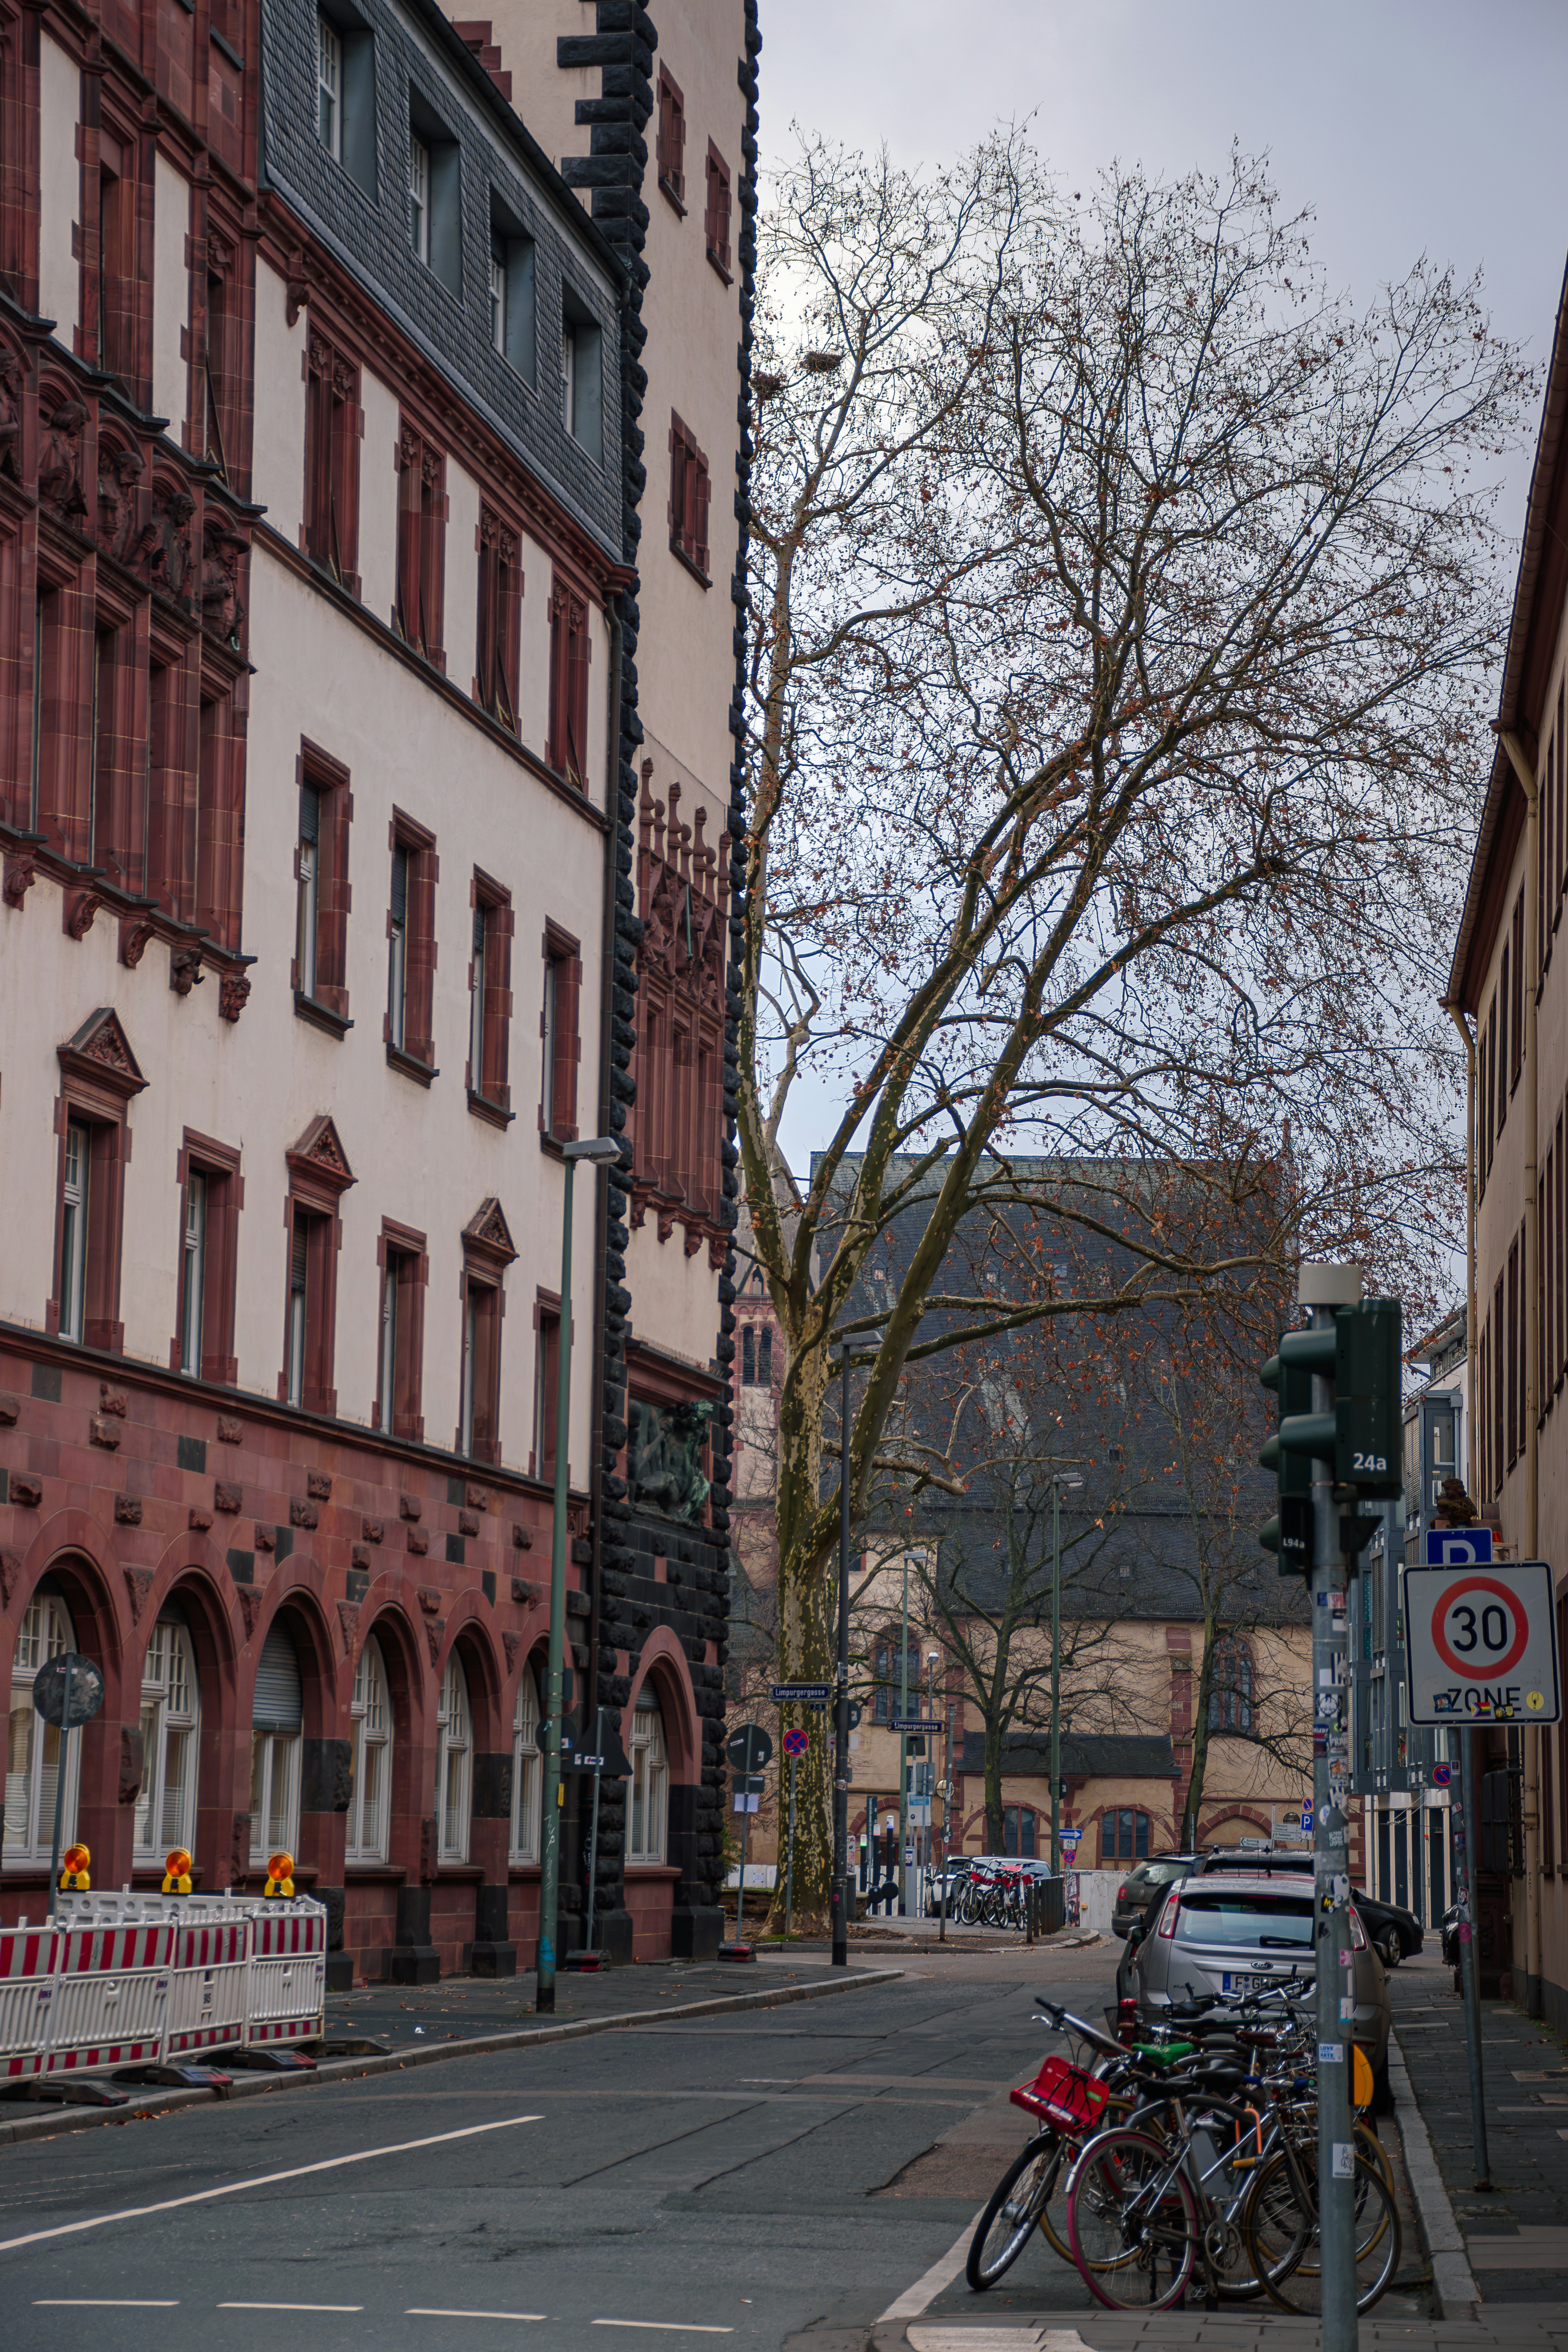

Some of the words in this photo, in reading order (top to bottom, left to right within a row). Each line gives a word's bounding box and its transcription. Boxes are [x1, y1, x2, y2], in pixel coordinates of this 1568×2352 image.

[1353, 1452, 1387, 1471] 24a
[1283, 1537, 1305, 1548] L94a
[1451, 1604, 1508, 1651] 30
[775, 1688, 825, 1697] Limpurgergasse
[1447, 1687, 1522, 1713] ZONE
[894, 1722, 938, 1731] Limpurgergasse
[1304, 1816, 1310, 1828] P
[1235, 1976, 1243, 1989] F
